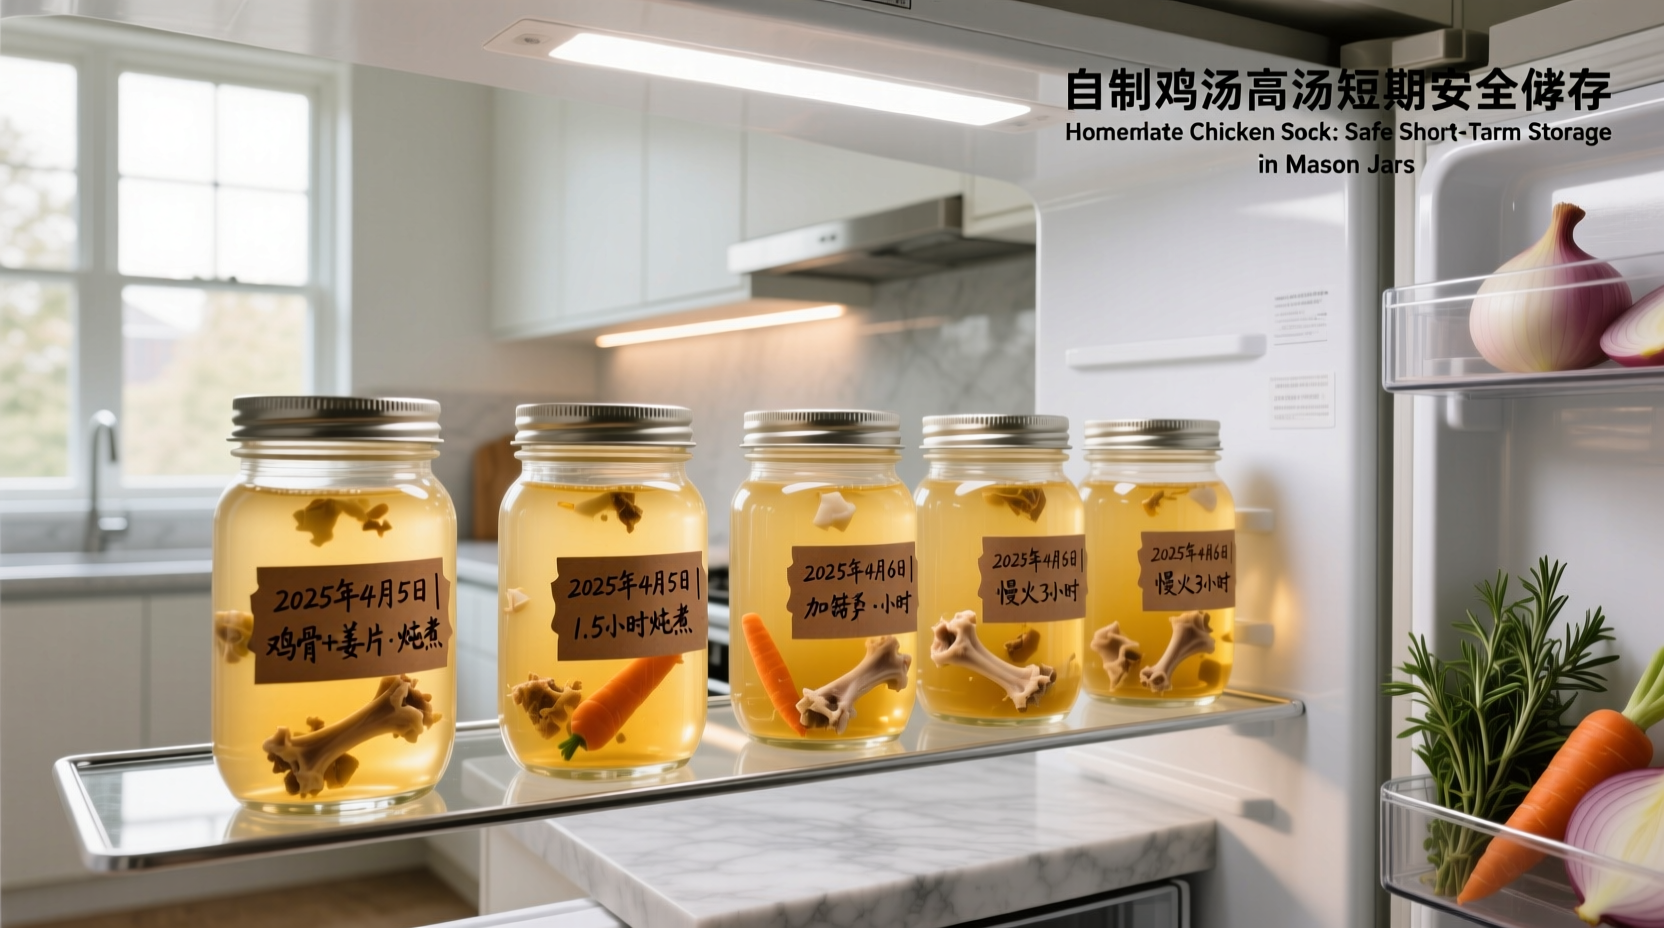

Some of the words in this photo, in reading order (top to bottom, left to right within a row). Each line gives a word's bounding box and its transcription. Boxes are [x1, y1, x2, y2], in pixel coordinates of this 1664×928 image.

[997, 579, 1079, 606] 慢火3小时
[1156, 571, 1230, 595] 慢火3小时
[574, 604, 692, 640] 1.5小时炖煮
